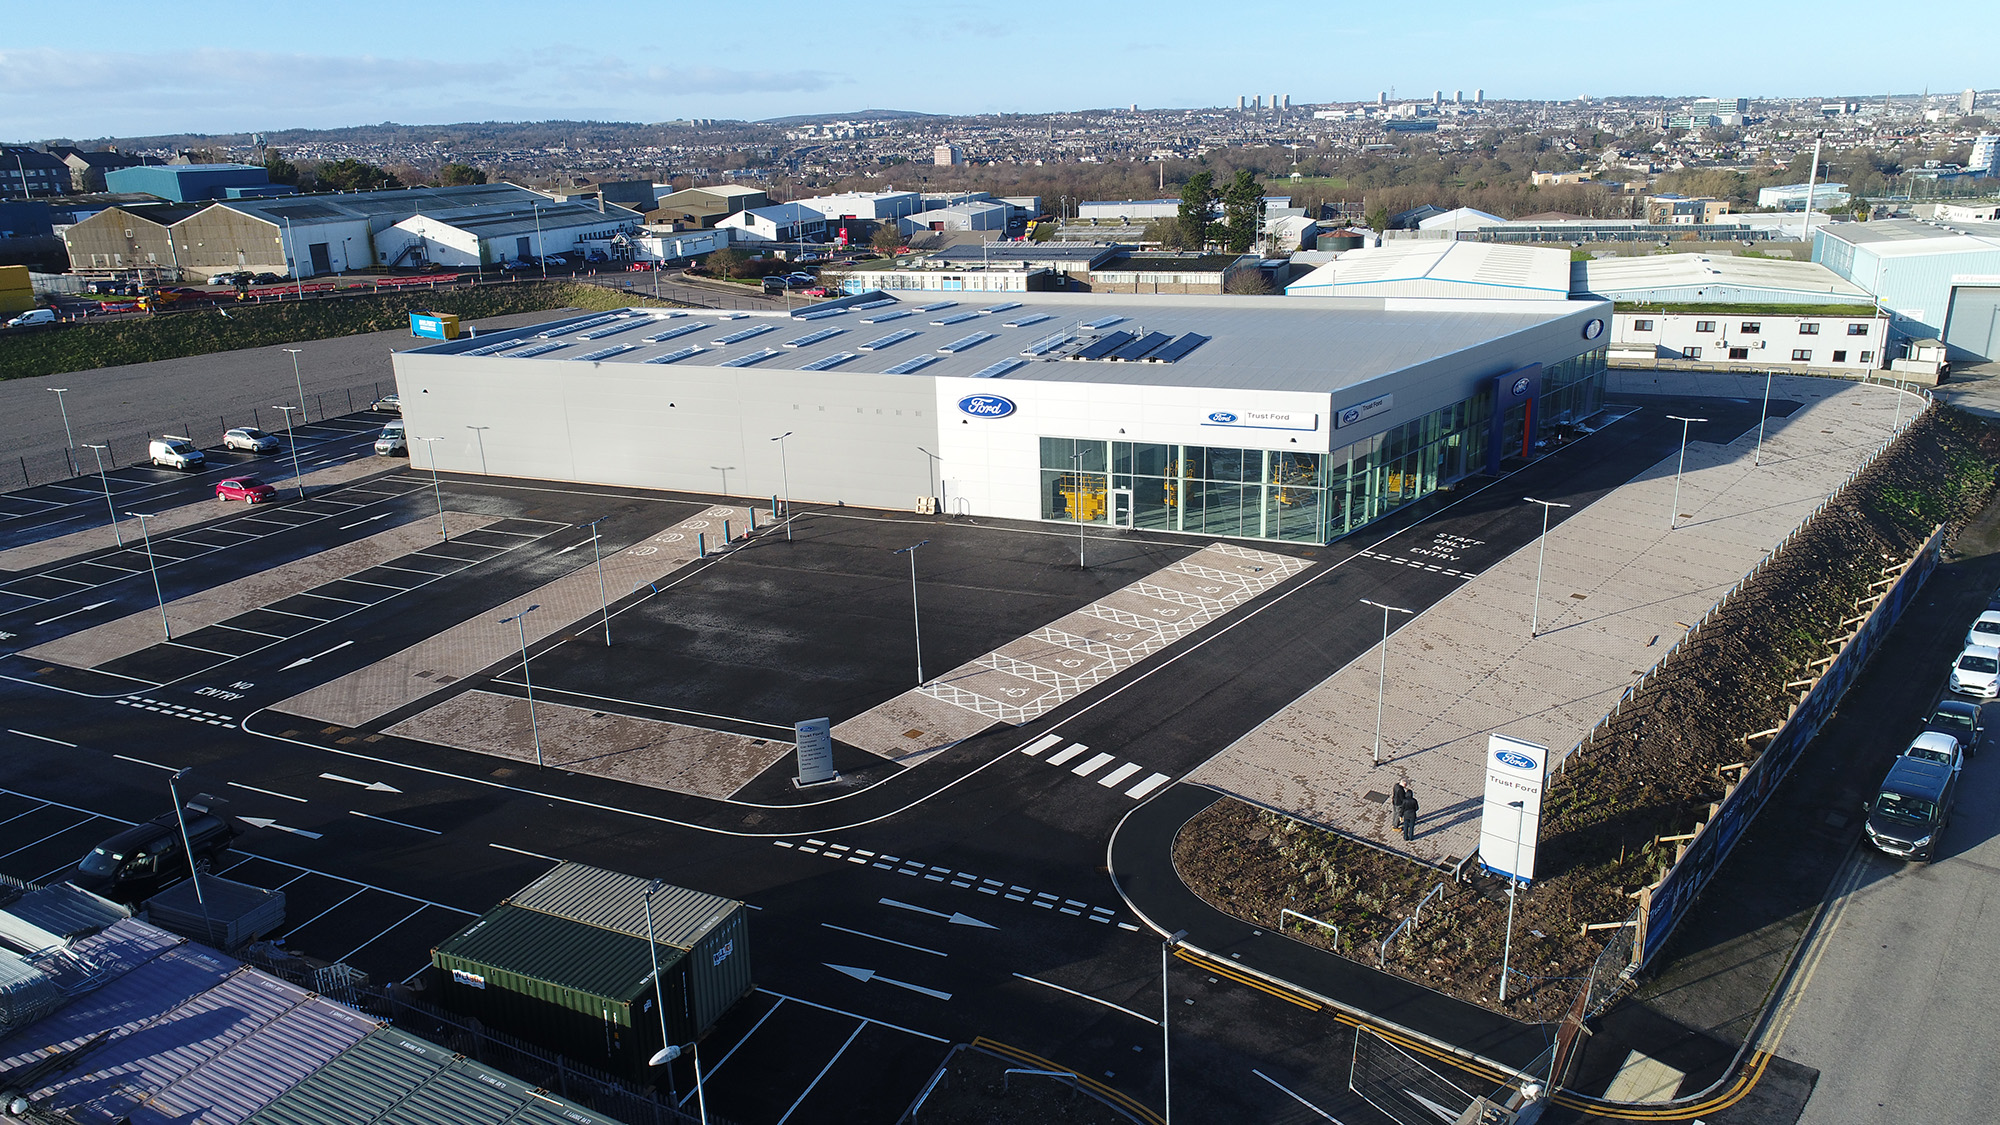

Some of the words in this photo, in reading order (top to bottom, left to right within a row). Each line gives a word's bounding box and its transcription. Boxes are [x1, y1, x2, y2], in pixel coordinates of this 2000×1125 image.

[966, 396, 1004, 415] Ford
[1248, 412, 1268, 420] Trust
[1270, 413, 1290, 421] Ford
[1433, 538, 1471, 550] ONLY
[1436, 532, 1486, 545] STAFF
[1409, 547, 1461, 561] ENTRY
[1432, 545, 1453, 553] NO
[228, 680, 255, 690] NO
[193, 686, 246, 701] ENTRY
[1500, 752, 1529, 768] Ford
[1490, 775, 1513, 788] Trust
[1514, 783, 1538, 794] Ford
